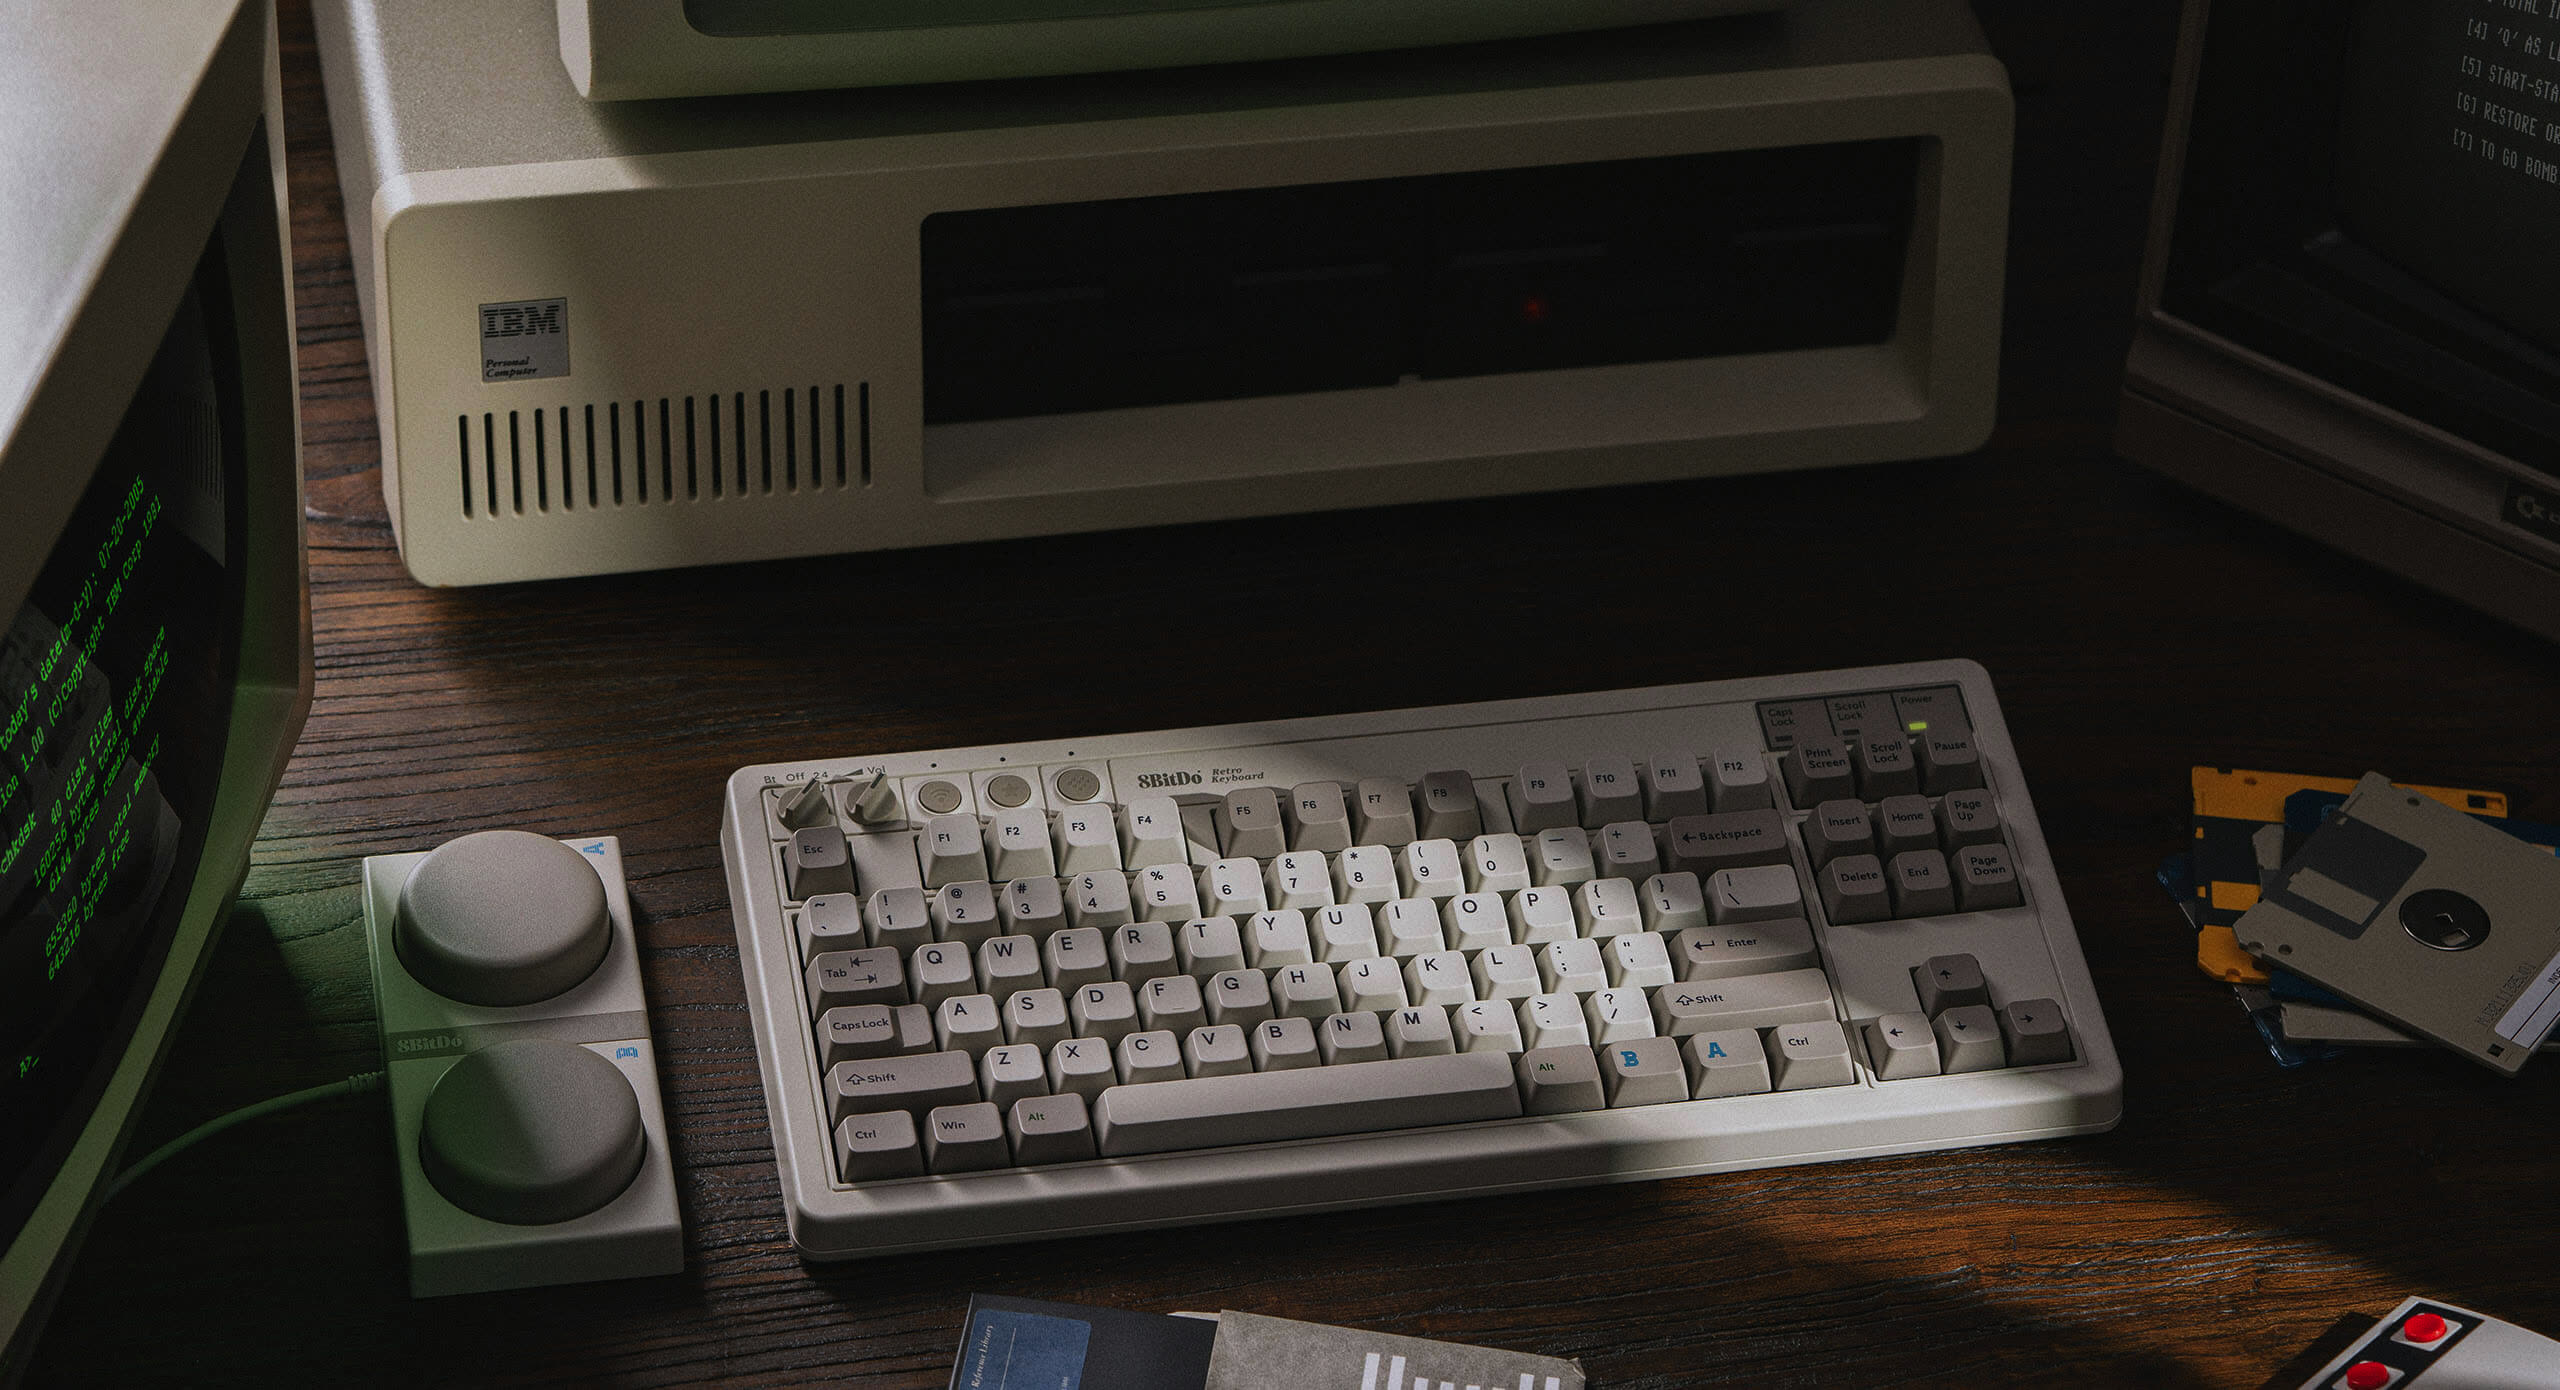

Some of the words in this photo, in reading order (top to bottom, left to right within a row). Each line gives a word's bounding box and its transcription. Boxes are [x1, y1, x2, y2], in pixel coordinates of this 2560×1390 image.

[2467, 18, 2488, 40] [4]
[2524, 35, 2542, 56] AS
[2461, 55, 2482, 78] [5]
[2457, 91, 2477, 114] [6]
[2483, 101, 2538, 137] RESTORE
[2453, 128, 2473, 151] [7]
[2481, 139, 2495, 161] TO
[2502, 147, 2518, 169] GO
[484, 305, 560, 338] IBM
[486, 356, 530, 368] Personal
[487, 368, 537, 378] Computer
[98, 472, 144, 569] 07-20-2005
[106, 576, 122, 616] IBM
[122, 539, 143, 580] Corp
[143, 494, 161, 537] 1981
[1901, 694, 1933, 704] Power
[1834, 701, 1866, 711] Scroll
[1768, 708, 1793, 719] Caps
[1838, 711, 1864, 721] Lock
[1771, 718, 1796, 727] Lock
[1871, 741, 1902, 753] Scroll
[1934, 741, 1967, 751] Pause
[1805, 748, 1832, 758] Print
[1873, 753, 1899, 763] Lock
[50, 799, 63, 825] 40
[65, 757, 87, 800] disk
[89, 705, 112, 757] files
[1724, 762, 1742, 771] F12
[1808, 758, 1846, 769] Screen
[69, 773, 95, 825] bytes
[98, 718, 122, 771] total
[868, 766, 886, 776] Vol
[1212, 767, 1242, 776] Retro
[1660, 768, 1676, 778] F11
[786, 772, 805, 782] Off
[1137, 771, 1202, 789] 8BitDo
[1211, 772, 1265, 784] Keyboard
[1595, 774, 1615, 783] F10
[1531, 779, 1545, 789] F9
[1368, 794, 1381, 804] F7
[1433, 789, 1448, 798] F8
[1302, 800, 1317, 810] F6
[1954, 799, 1982, 810] Page
[1236, 806, 1251, 816] F5
[1892, 811, 1924, 822] Home
[1958, 811, 1974, 821] Up
[1137, 815, 1152, 825] F4
[1828, 816, 1861, 827] Insert
[1005, 827, 1020, 836] F2
[1071, 822, 1086, 832] F3
[938, 834, 950, 843] F1
[1700, 828, 1762, 842] Backspace
[49, 847, 72, 893] 6144
[74, 797, 100, 850] bytes
[80, 847, 106, 898] bytes
[108, 792, 132, 845] total
[111, 828, 131, 870] free
[803, 845, 823, 855] Esc
[1970, 856, 1998, 867] Page
[1419, 866, 1430, 877] 9
[1841, 871, 1879, 882] Delete
[1908, 867, 1930, 877] End
[1974, 866, 2006, 876] Down
[1354, 872, 1364, 882] 8
[1289, 878, 1297, 889] 7
[1222, 884, 1232, 895] 6
[1156, 891, 1167, 901] 5
[1526, 893, 1539, 906] P
[1088, 897, 1098, 908] 4
[955, 908, 965, 919] 2
[1021, 903, 1031, 914] 3
[886, 915, 893, 925] 1
[1328, 911, 1343, 925] U
[1263, 917, 1275, 931] Y
[1194, 924, 1206, 938] T
[1127, 930, 1141, 944] R
[1727, 937, 1758, 948] Enter
[1061, 936, 1073, 950] E
[994, 942, 1013, 957] W
[926, 950, 943, 964] Q
[1491, 952, 1503, 965] L
[1423, 958, 1439, 971] K
[825, 968, 847, 979] Tab
[1358, 964, 1370, 977] J
[1290, 970, 1305, 984] H
[1224, 977, 1239, 991] G
[1154, 983, 1165, 997] F
[1089, 989, 1104, 1003] D
[1695, 993, 1724, 1004] Shift
[954, 1002, 967, 1016] A
[1021, 997, 1034, 1010] S
[1403, 1012, 1420, 1025] M
[833, 1021, 861, 1031] Caps
[862, 1018, 889, 1029] Lock
[1336, 1018, 1351, 1032] N
[1269, 1025, 1283, 1038] B
[397, 1036, 463, 1052] 8BitDo
[1202, 1032, 1216, 1046] V
[1787, 1036, 1810, 1047] Ctrl
[1135, 1039, 1149, 1051] C
[1708, 1042, 1727, 1059] A
[1065, 1045, 1080, 1058] X
[997, 1052, 1011, 1065] Z
[1621, 1051, 1639, 1068] B
[1538, 1061, 1556, 1073] Alt
[867, 1073, 896, 1083] Shift
[1028, 1113, 1045, 1122] Alt
[941, 1120, 965, 1130] Win
[854, 1130, 876, 1140] Ctrl
